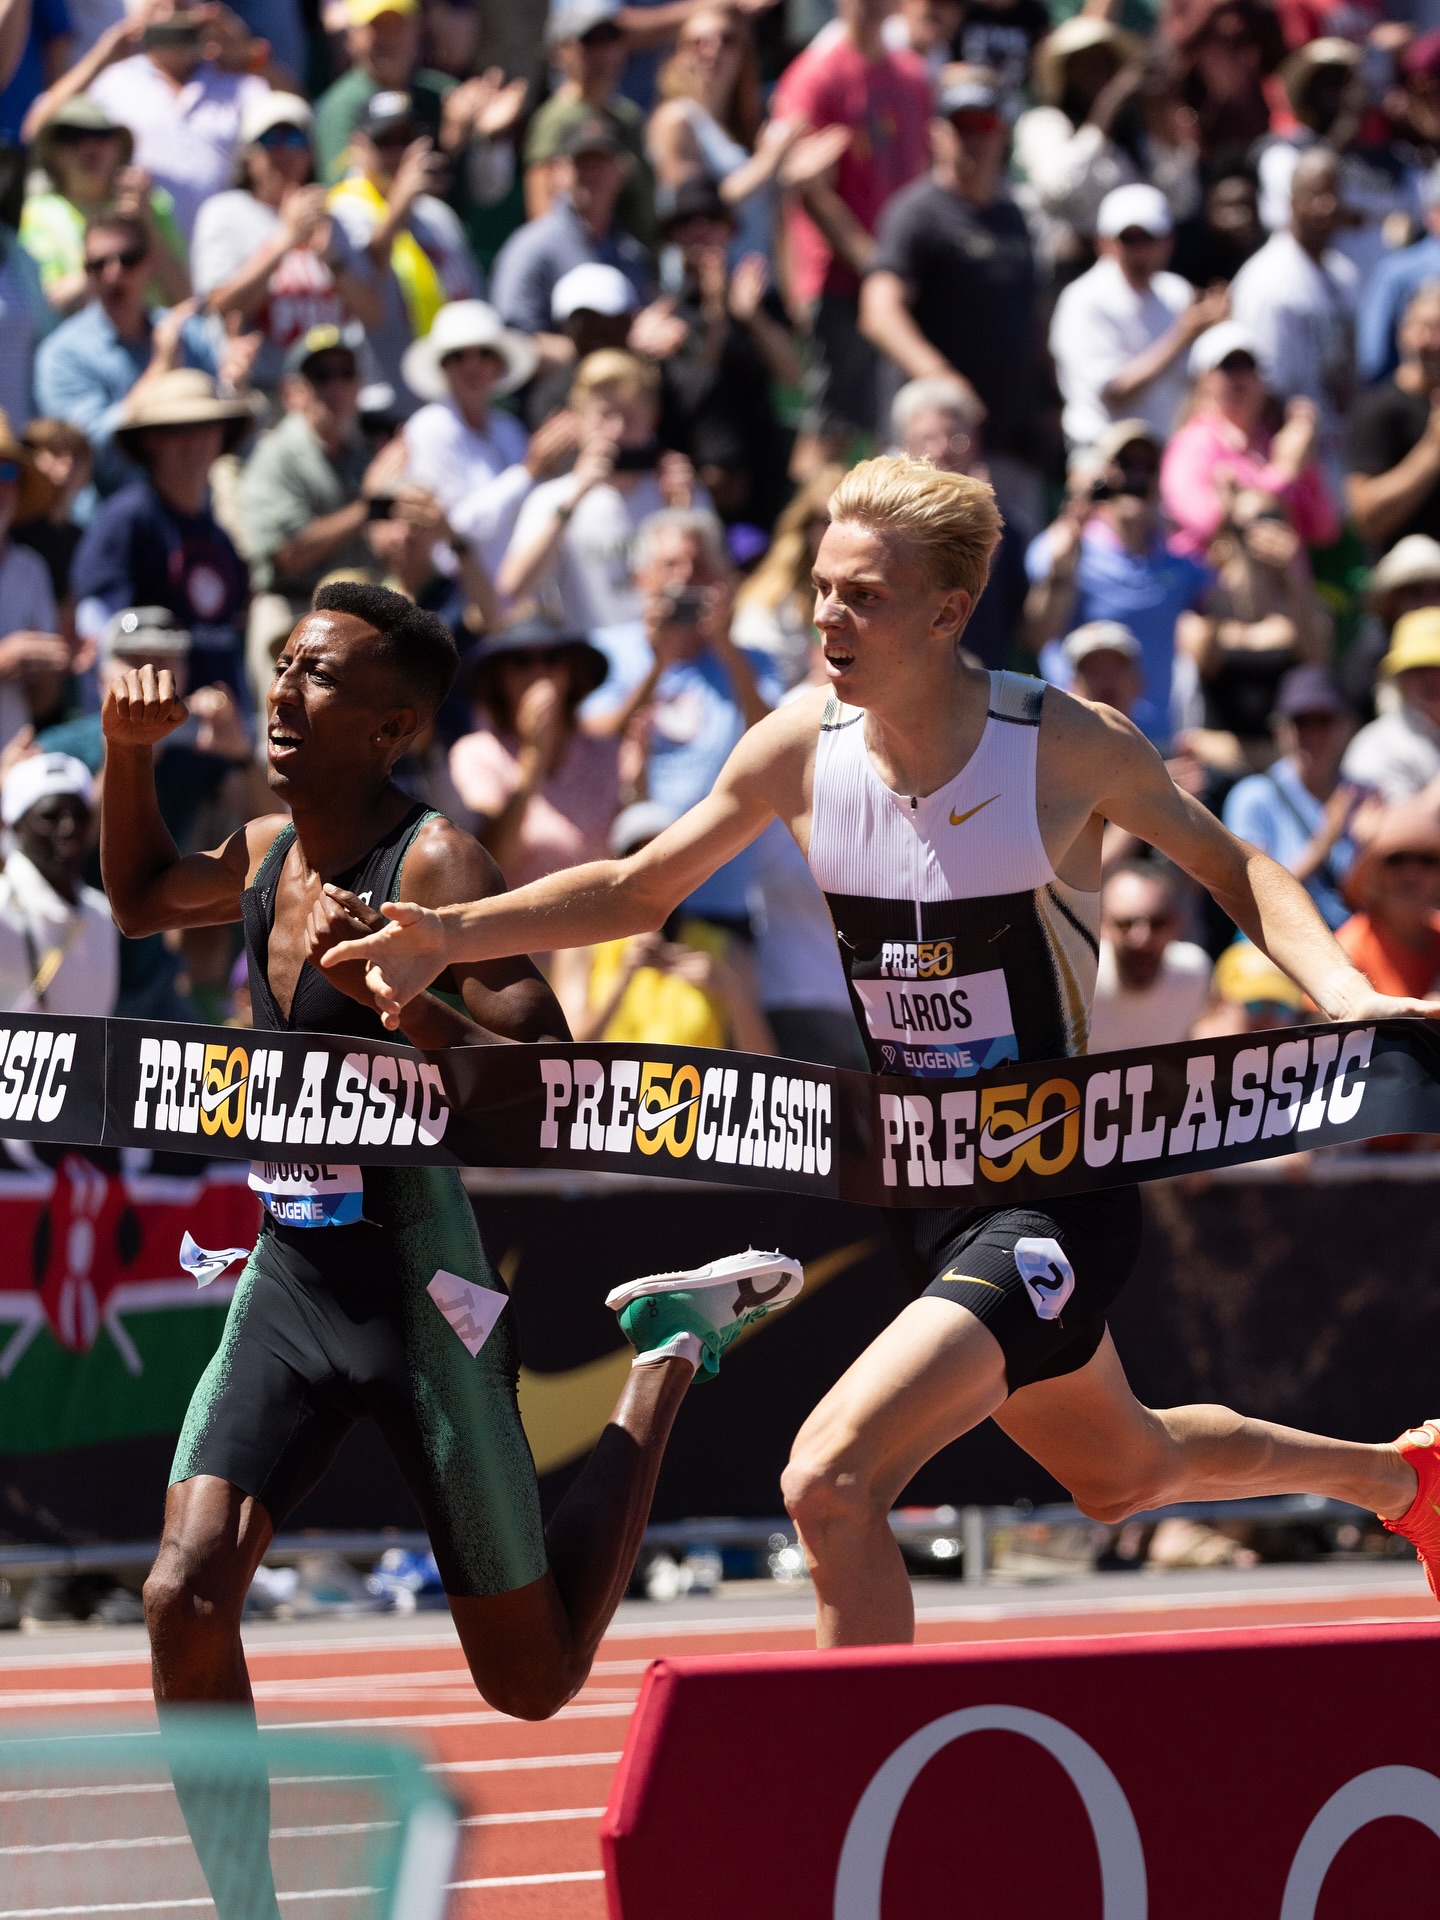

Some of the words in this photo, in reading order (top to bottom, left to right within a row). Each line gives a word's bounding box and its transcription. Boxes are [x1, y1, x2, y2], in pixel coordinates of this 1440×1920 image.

[886, 989, 973, 1032] LAROS
[903, 1050, 974, 1069] EUGENE
[0, 1029, 77, 1123] SIC
[270, 1201, 325, 1220] EUGENE
